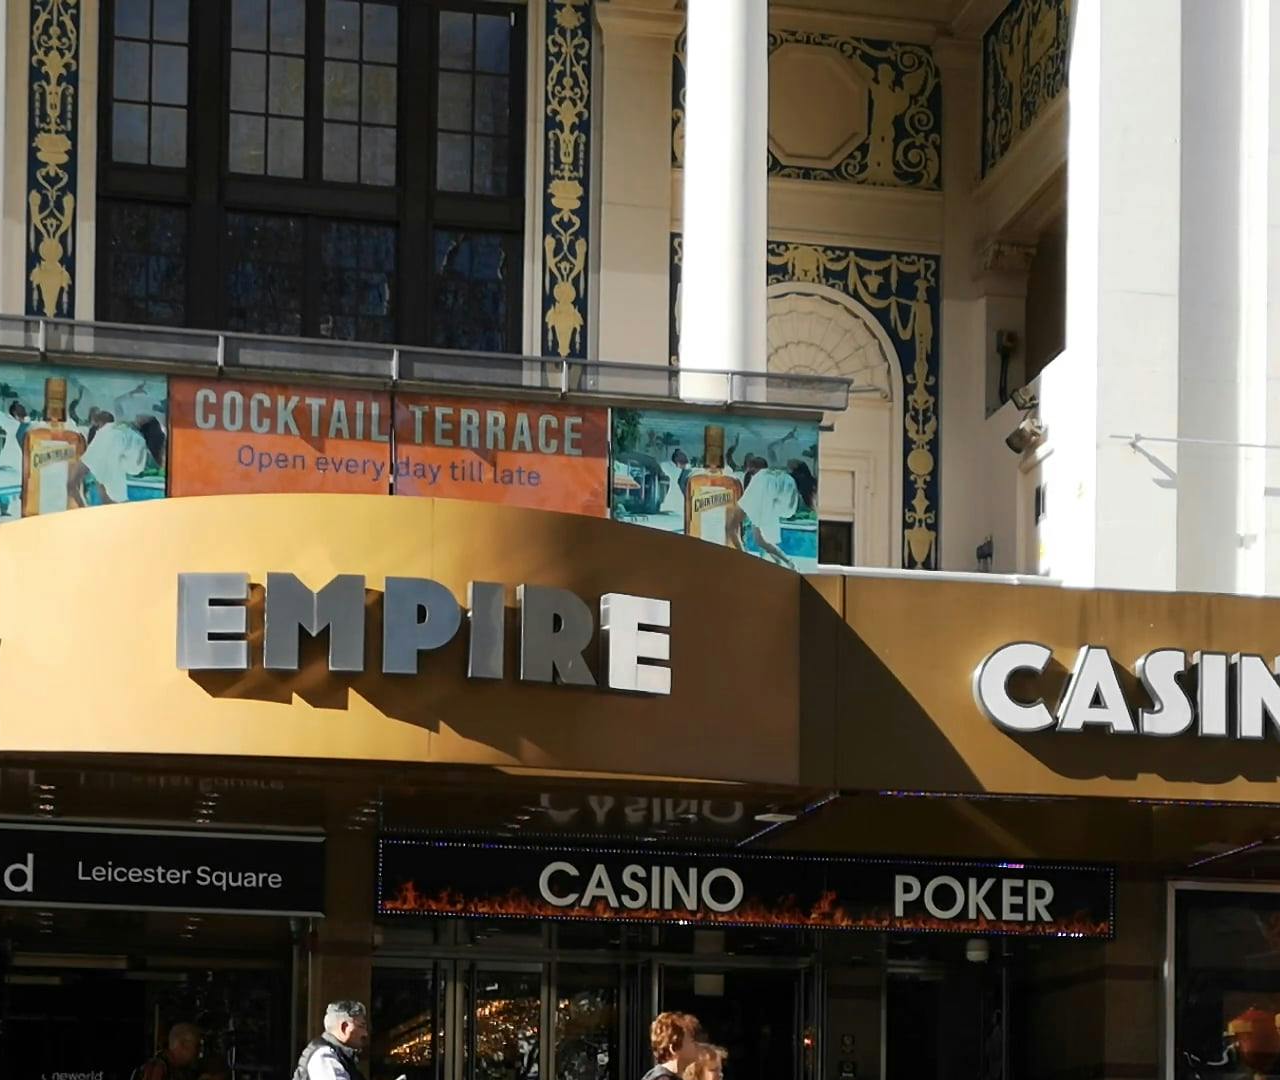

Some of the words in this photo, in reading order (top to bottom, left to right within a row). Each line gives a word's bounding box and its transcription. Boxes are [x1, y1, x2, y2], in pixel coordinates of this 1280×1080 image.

[194, 387, 389, 442] COCKTAIL
[409, 403, 583, 457] TERRACE
[237, 444, 306, 471] Open
[315, 457, 386, 482] every
[395, 456, 442, 484] day
[449, 460, 483, 484] till
[493, 464, 542, 488] late
[176, 571, 672, 696] EMPIRE
[76, 860, 192, 887] Leicester
[195, 864, 284, 891] Square
[538, 861, 744, 912] CASINO
[894, 874, 1055, 923] POKER
